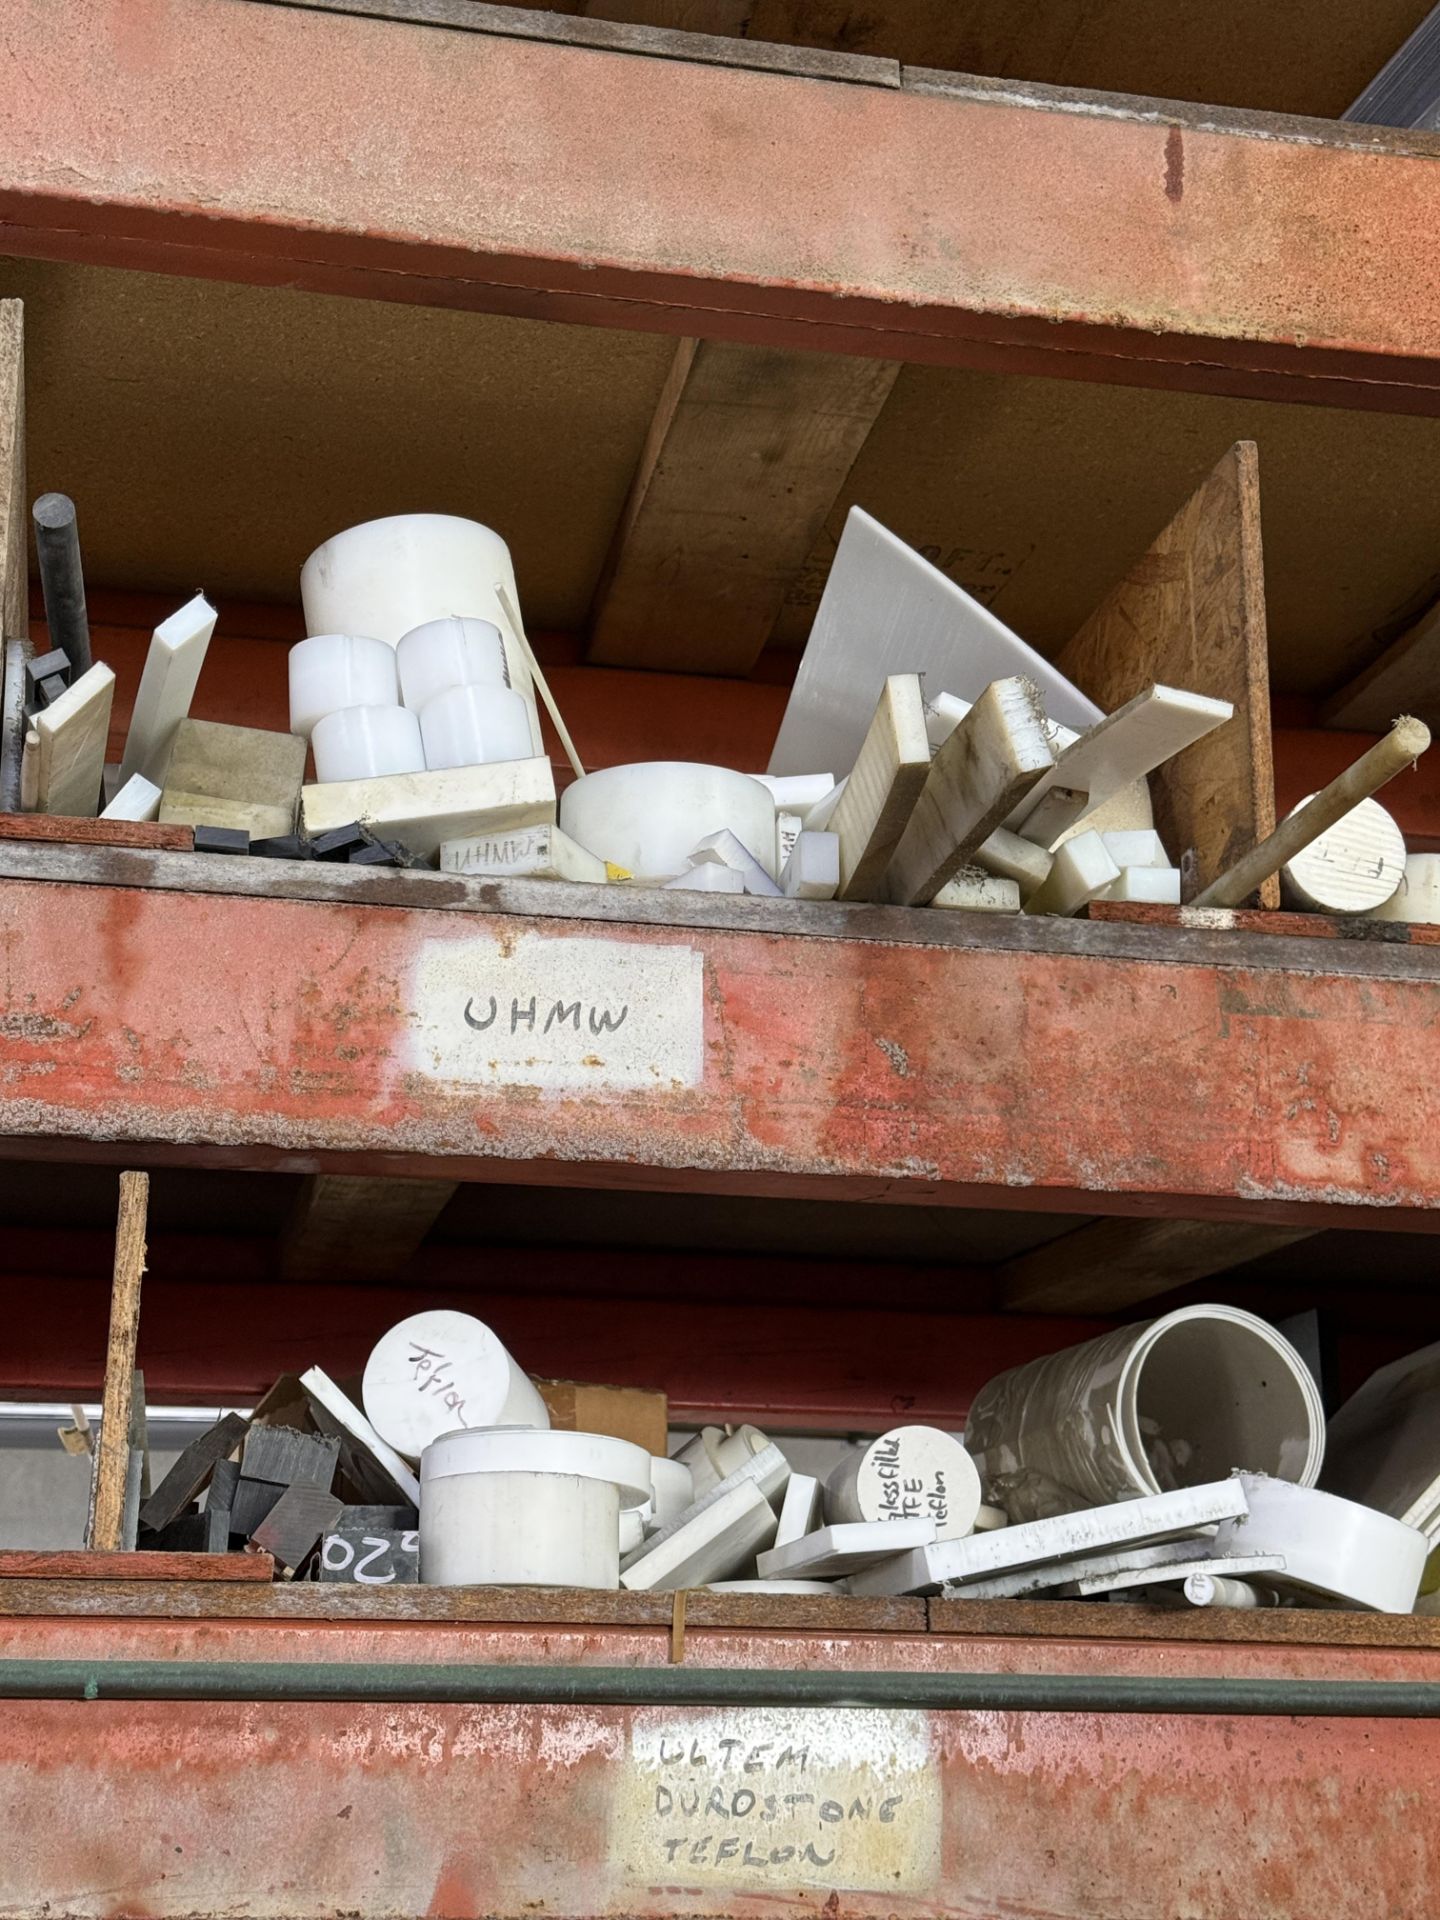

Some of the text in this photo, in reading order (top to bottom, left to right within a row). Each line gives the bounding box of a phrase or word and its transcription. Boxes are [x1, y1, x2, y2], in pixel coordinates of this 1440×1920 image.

[463, 995, 628, 1036] UHMW
[659, 1738, 810, 1773] ULTEM
[655, 1785, 903, 1824] DUROSTONE
[662, 1836, 835, 1867] TEFLON
